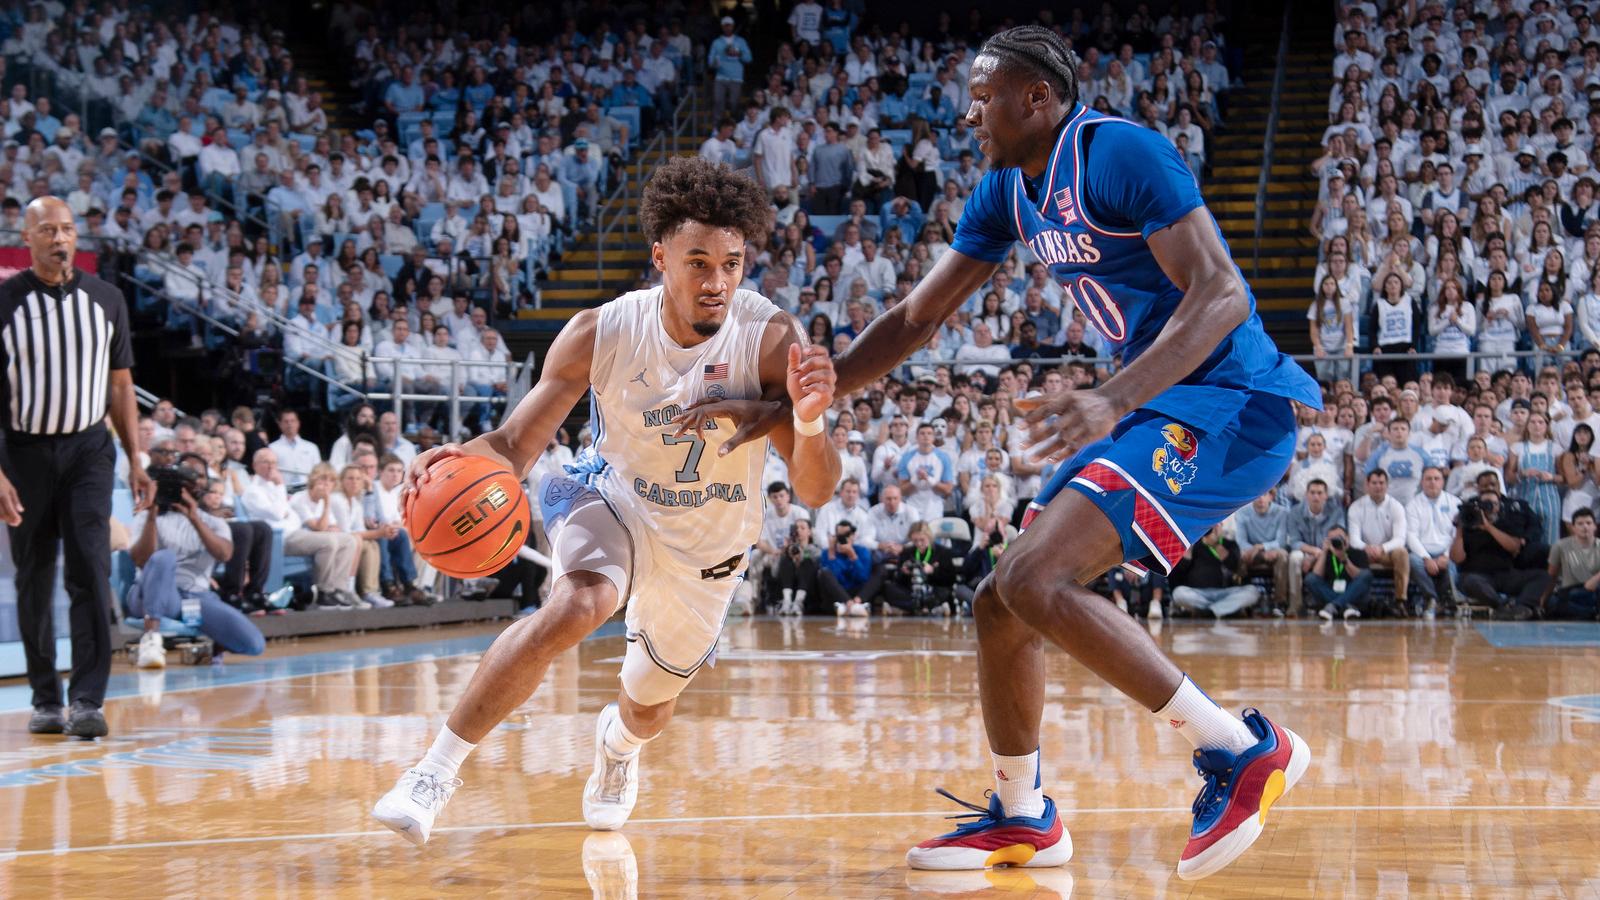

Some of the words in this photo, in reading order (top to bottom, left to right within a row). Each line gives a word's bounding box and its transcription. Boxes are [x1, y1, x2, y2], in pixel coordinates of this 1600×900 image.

[1063, 275, 1125, 341] 0
[643, 404, 718, 430] NOH
[661, 433, 706, 483] 7
[1170, 457, 1184, 473] KU
[450, 487, 509, 537] ELITE
[634, 477, 747, 508] CAROLINA
